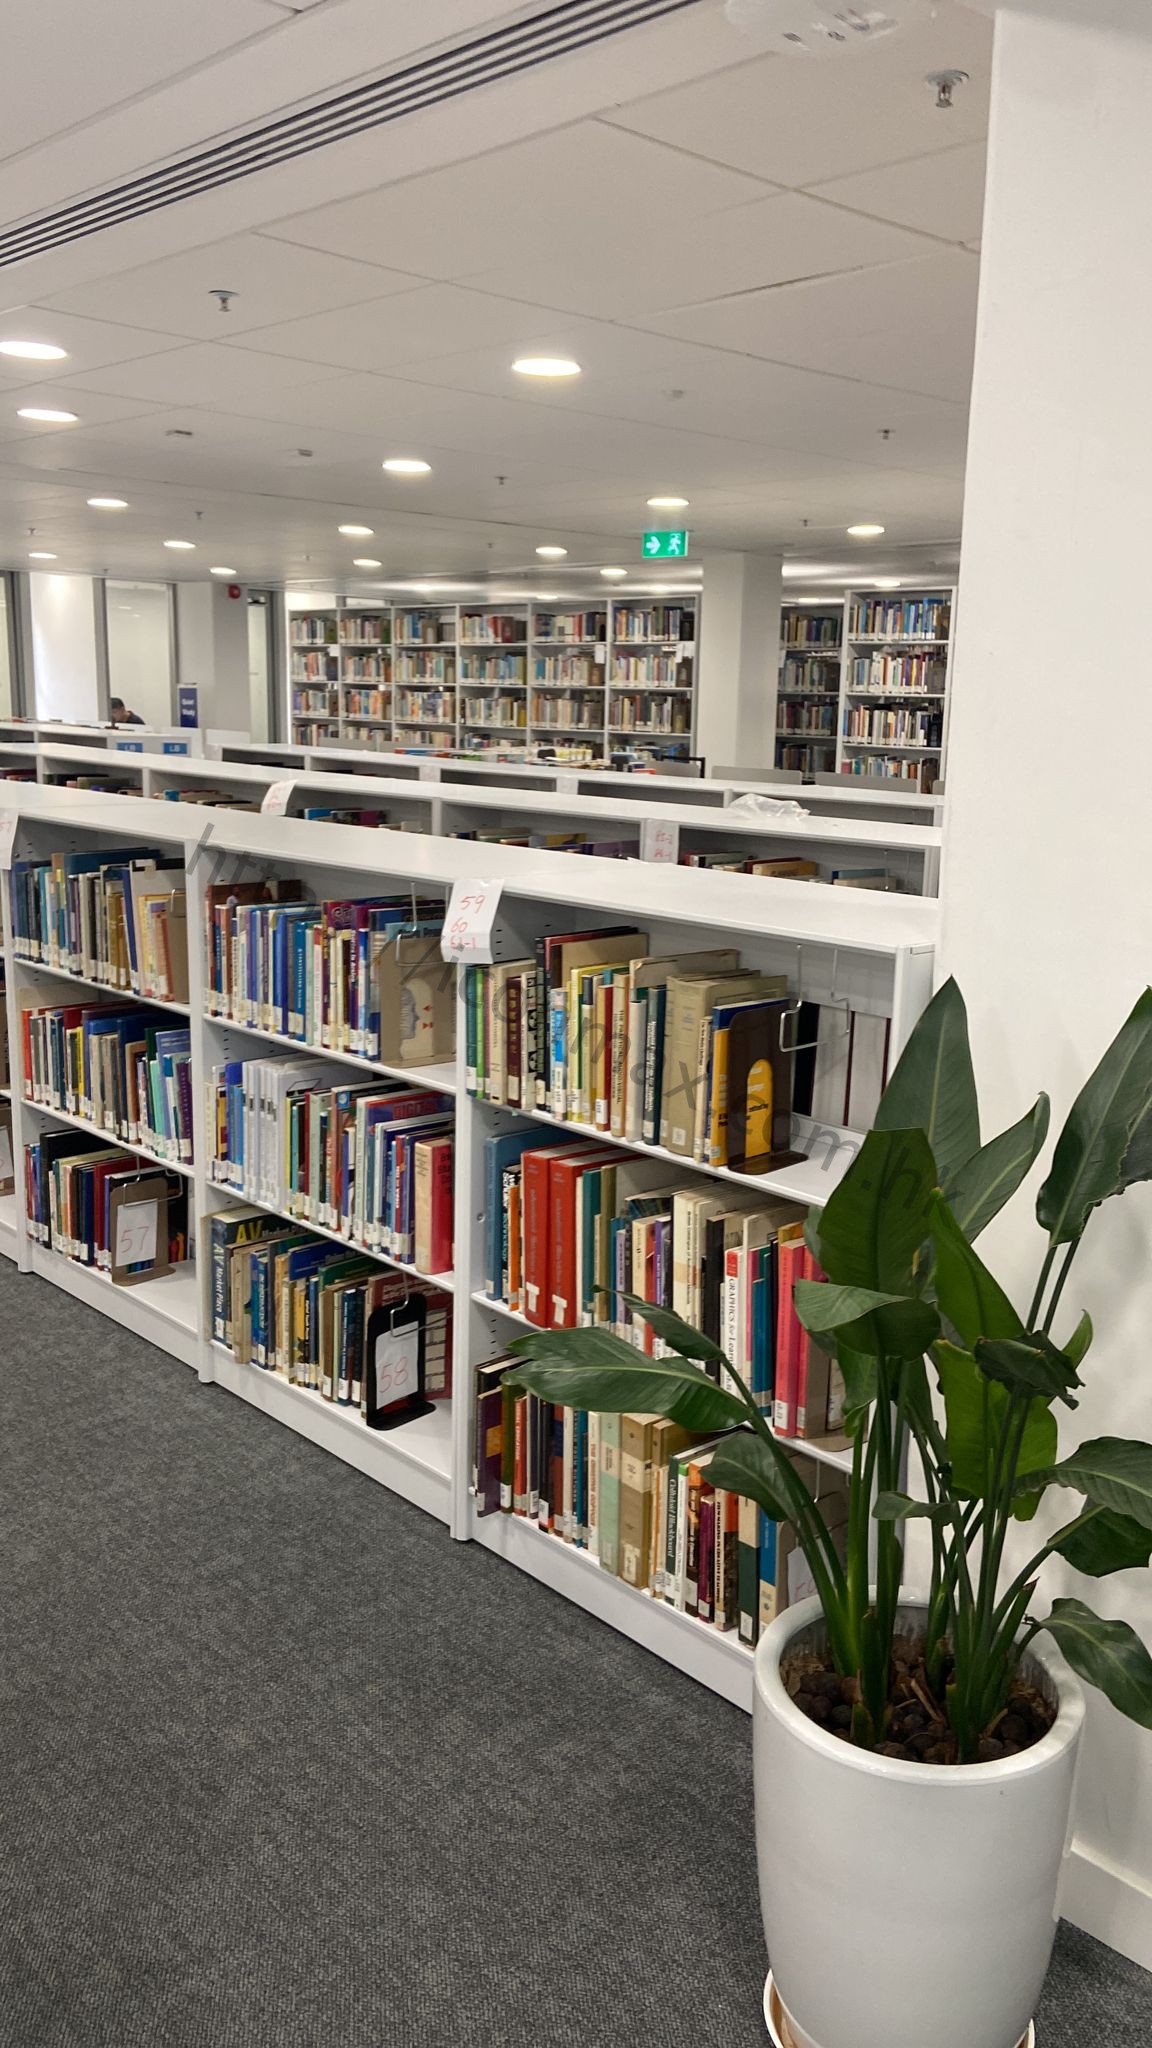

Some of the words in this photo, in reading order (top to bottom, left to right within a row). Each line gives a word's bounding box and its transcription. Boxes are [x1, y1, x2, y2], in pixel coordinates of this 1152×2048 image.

[460, 894, 486, 914] 59
[450, 917, 469, 933] 60
[120, 1225, 150, 1254] 57
[235, 1219, 263, 1243] AV
[213, 1243, 225, 1264] AV
[215, 1266, 225, 1293] Market
[215, 1293, 224, 1314] Place
[728, 1278, 737, 1322] GRAPHICS
[379, 1356, 409, 1394] 58
